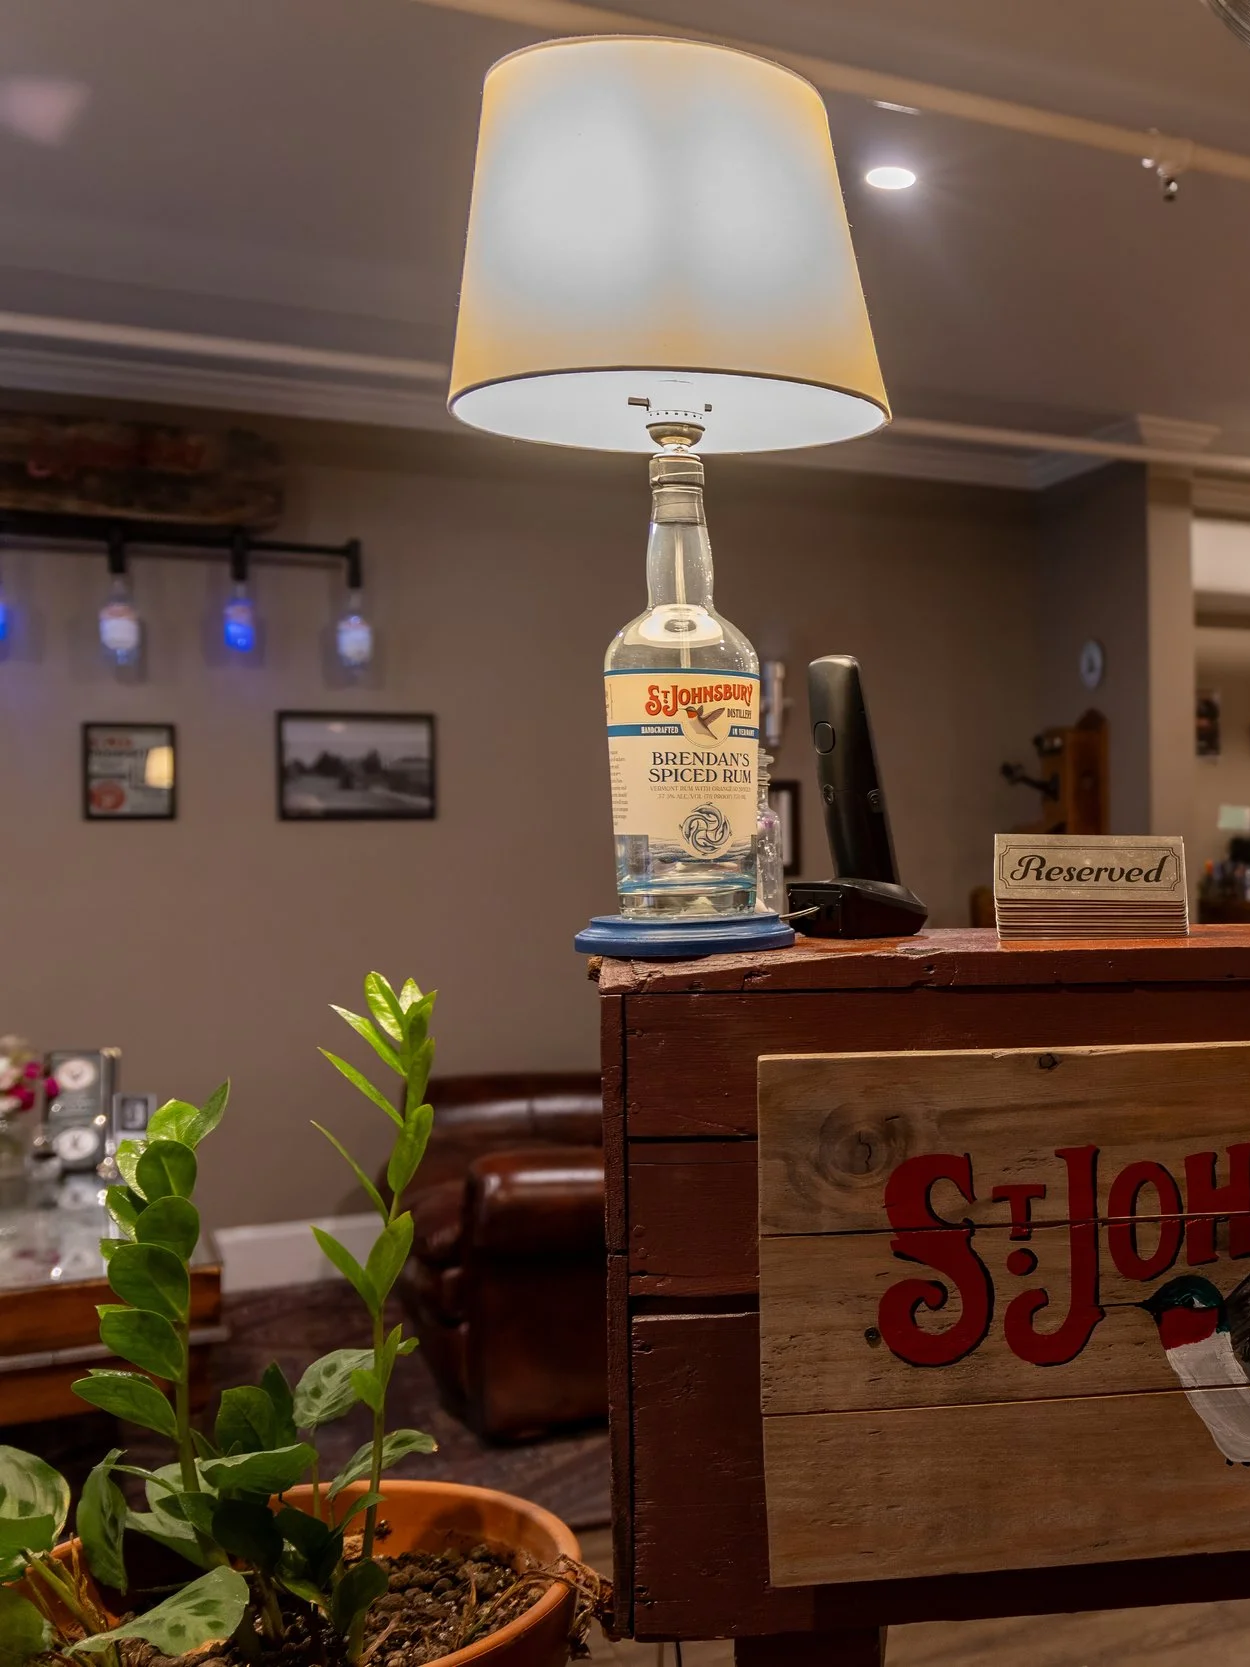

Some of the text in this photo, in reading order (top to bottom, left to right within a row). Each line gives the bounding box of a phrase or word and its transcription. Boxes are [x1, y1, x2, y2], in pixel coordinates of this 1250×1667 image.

[662, 683, 753, 717] JOHNSBURY
[640, 725, 679, 734] HANDCRAFTED
[651, 751, 750, 767] BRENDAN'S
[648, 768, 752, 784] SPICED RUM
[1009, 853, 1171, 884] Reserved
